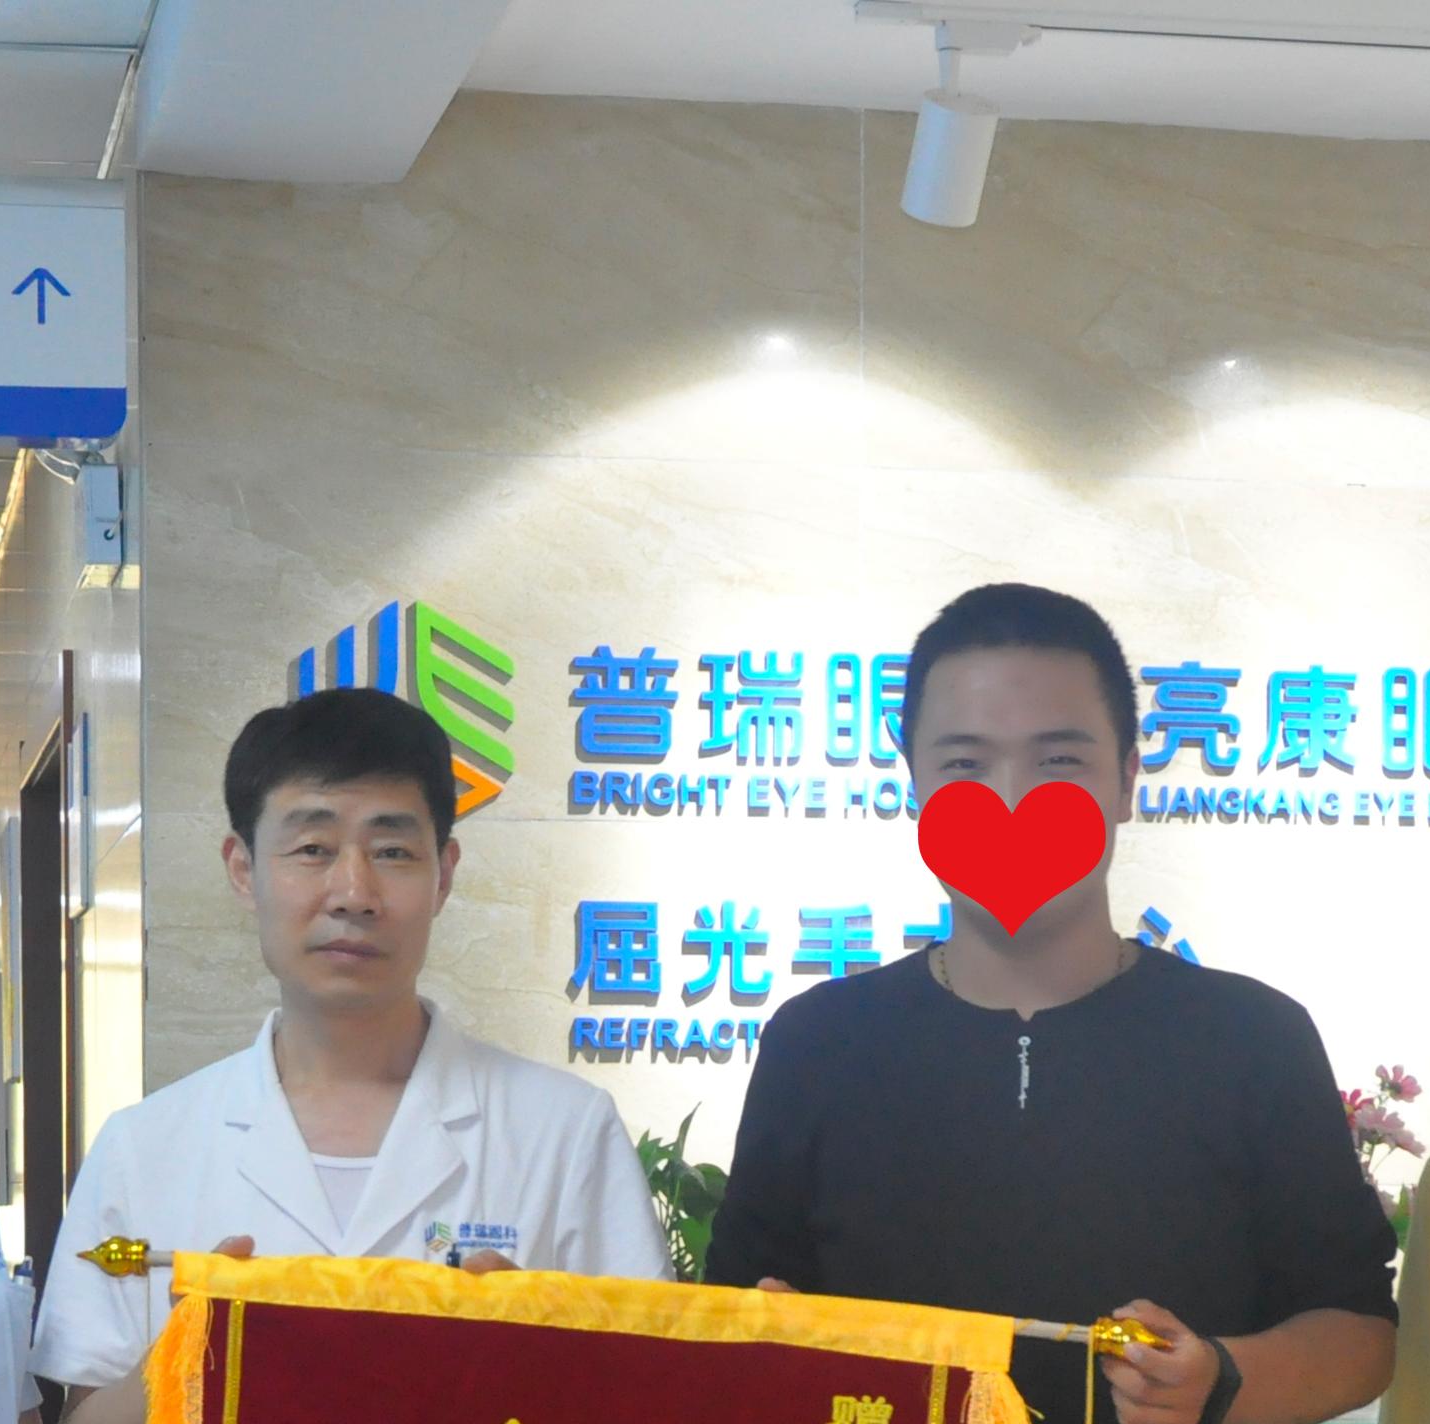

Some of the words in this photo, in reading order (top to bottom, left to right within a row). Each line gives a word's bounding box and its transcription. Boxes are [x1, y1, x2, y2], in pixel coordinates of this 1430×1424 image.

[572, 770, 731, 810] BRIGHT
[749, 775, 828, 810] EYE
[1138, 784, 1342, 819] LIANGKANG
[1353, 792, 1415, 820] EYE
[571, 900, 953, 995] 屈光手
